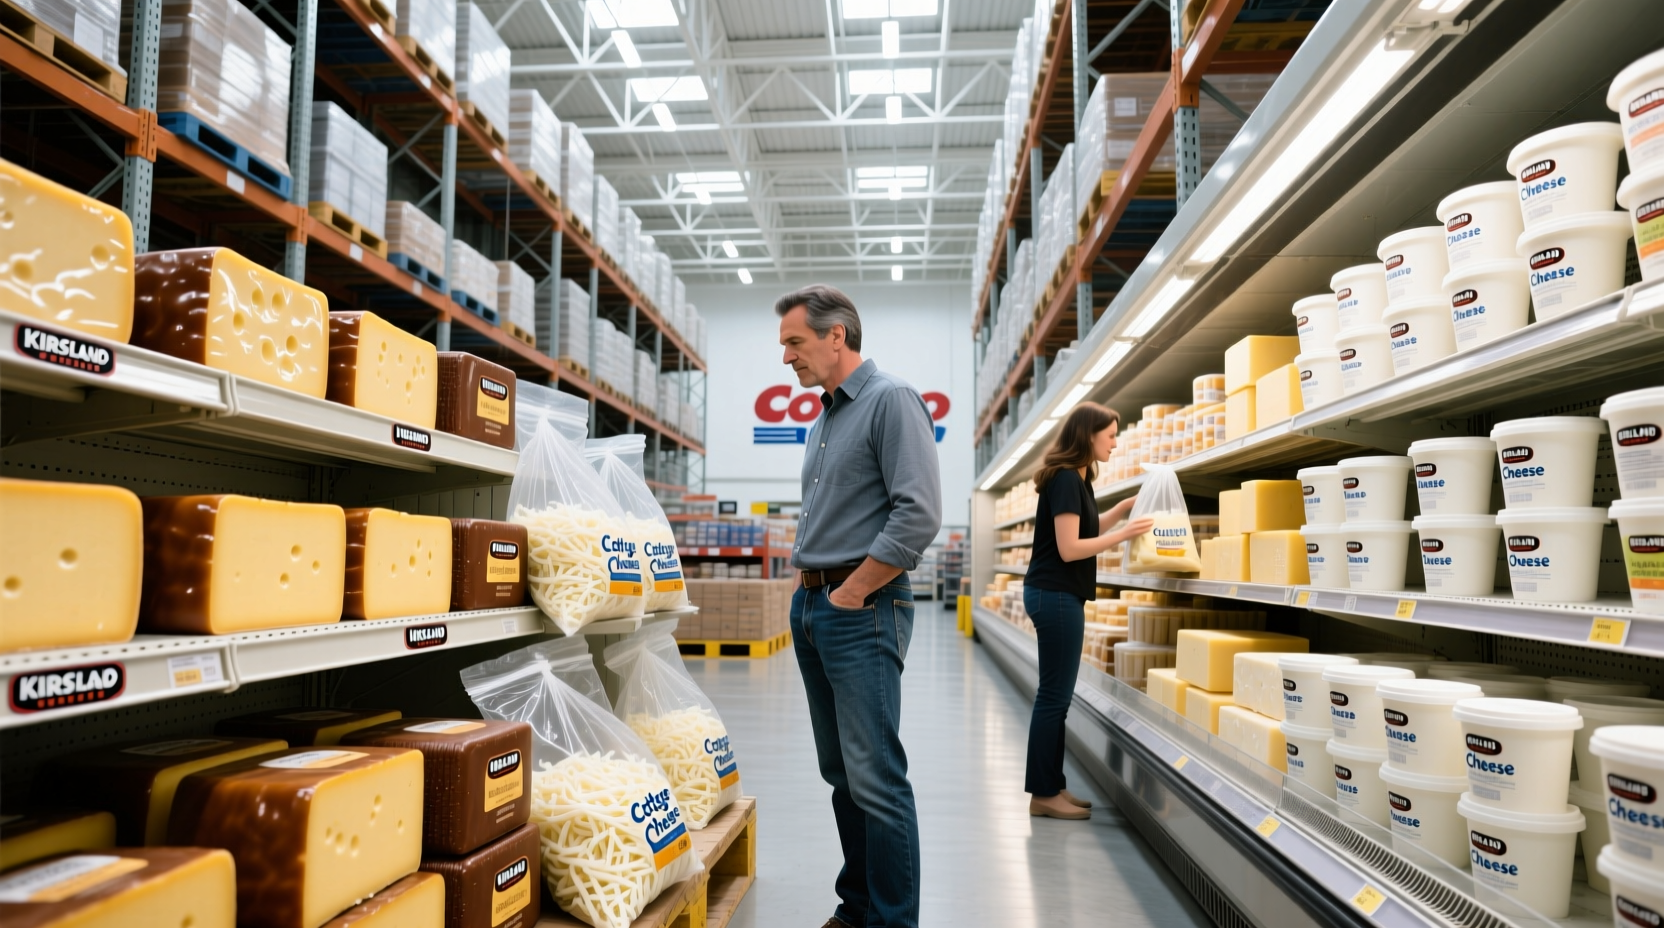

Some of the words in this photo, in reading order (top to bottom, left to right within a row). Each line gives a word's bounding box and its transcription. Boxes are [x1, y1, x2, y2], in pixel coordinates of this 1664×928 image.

[1502, 465, 1545, 480] Cheese
[19, 667, 118, 701] KIRSLAD
[1466, 752, 1515, 776] Cheese
